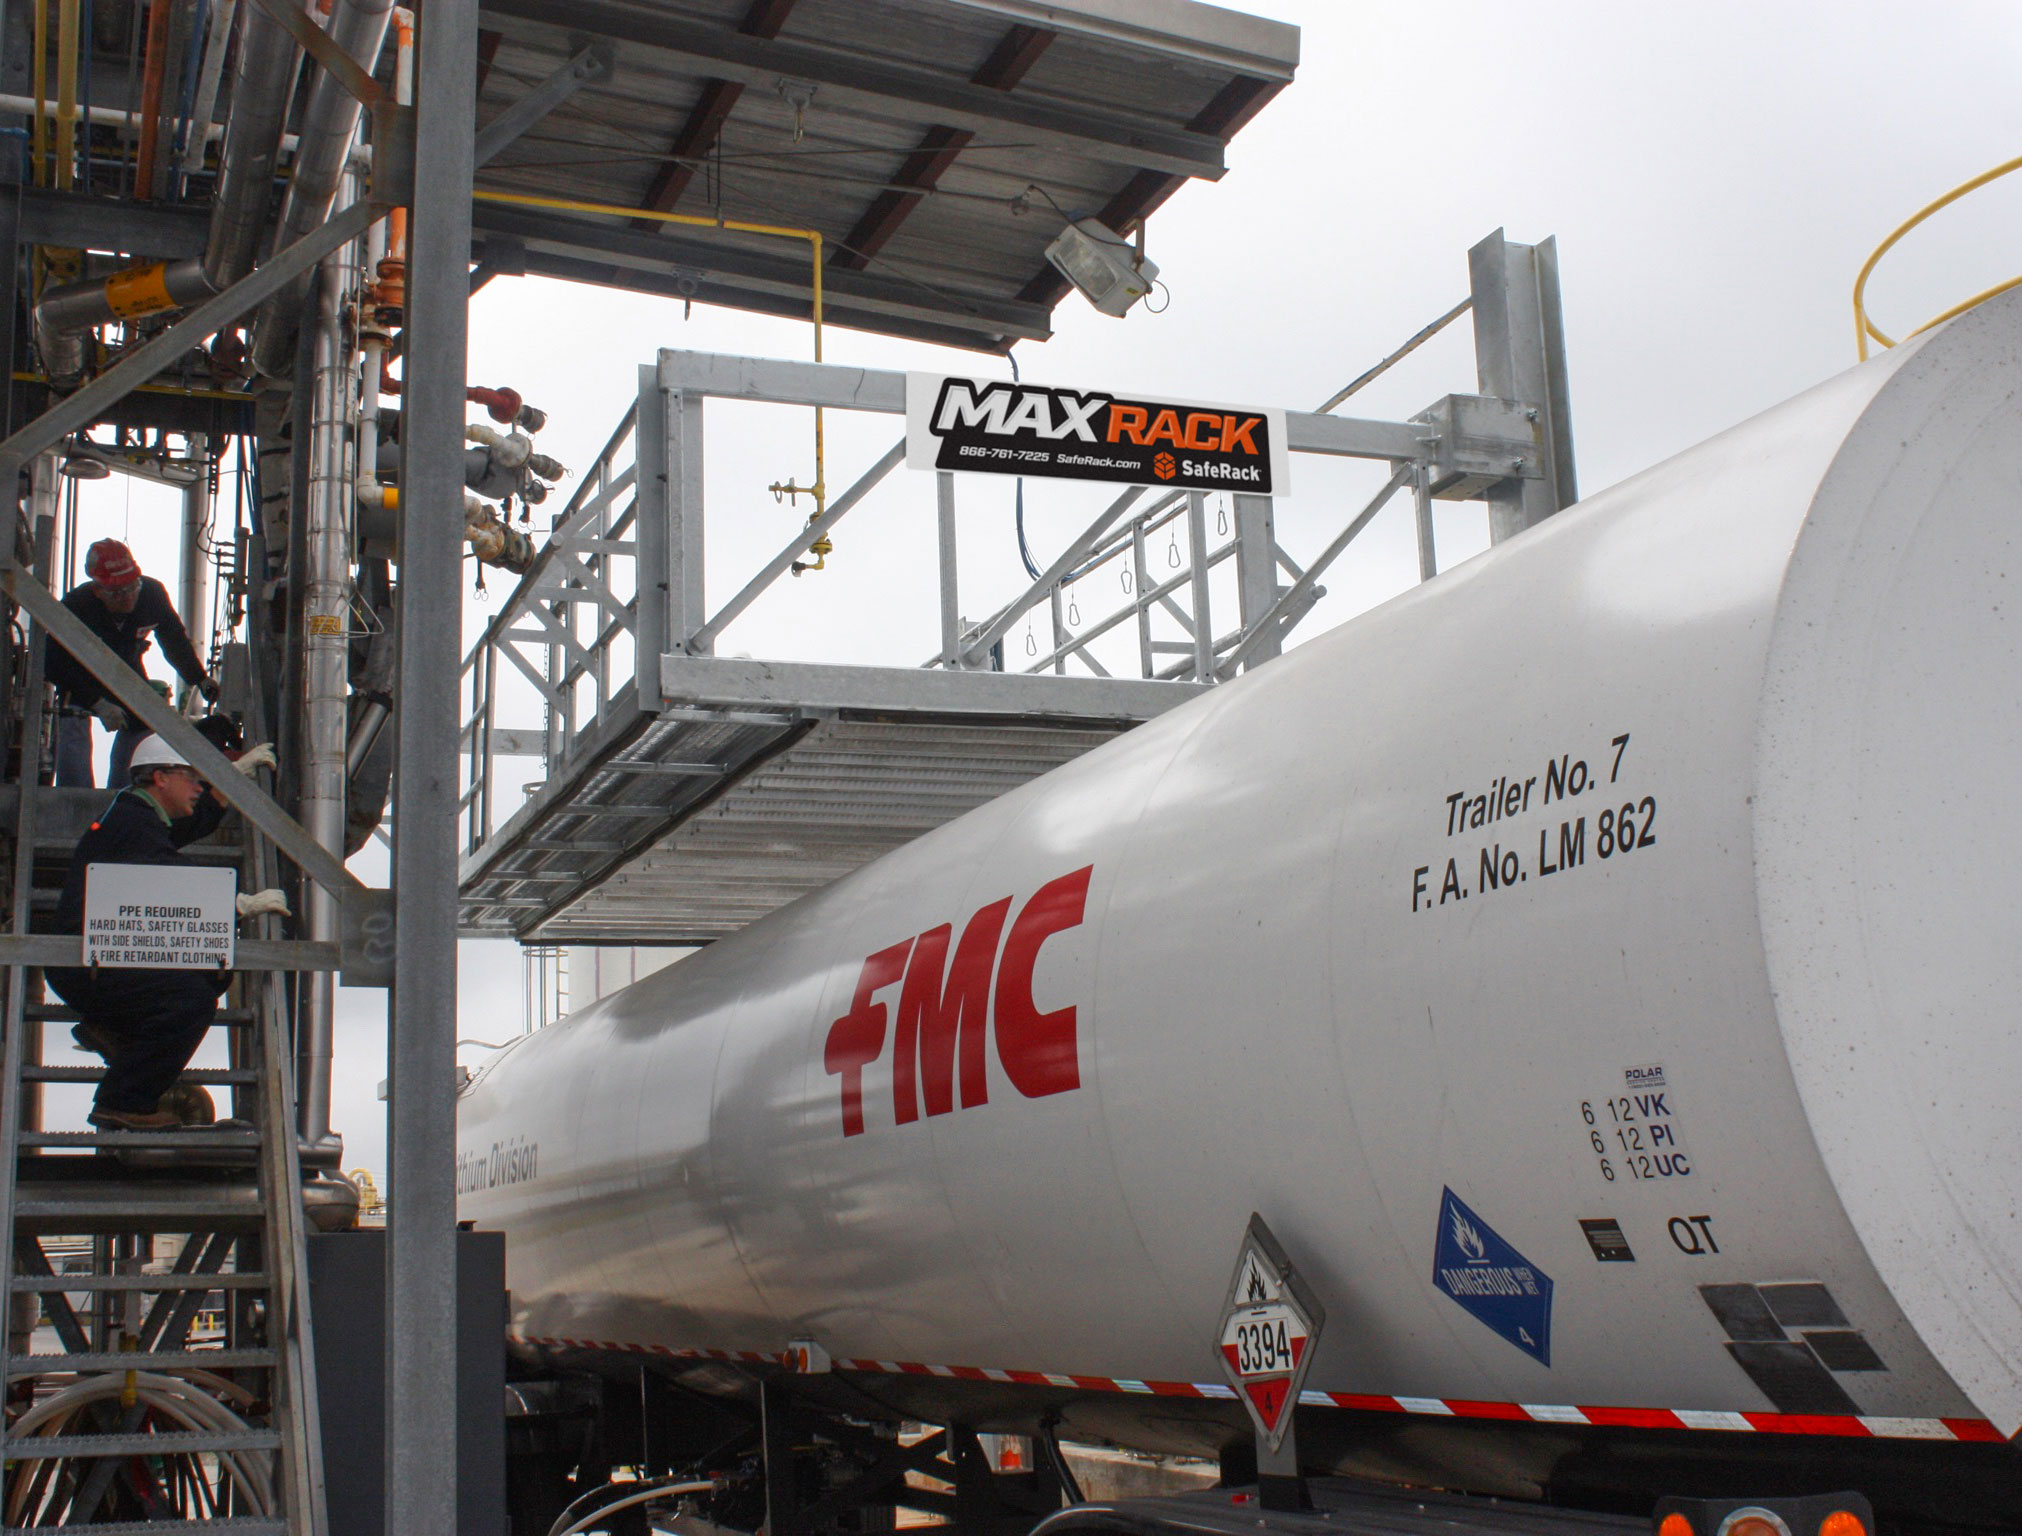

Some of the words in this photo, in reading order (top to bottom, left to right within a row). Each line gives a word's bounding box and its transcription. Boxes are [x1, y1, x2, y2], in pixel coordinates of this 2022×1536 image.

[959, 446, 1050, 462] 866-761-7225
[1056, 453, 1141, 469] SafeRack.com
[1181, 459, 1261, 481] SafeRack
[1446, 776, 1537, 837] Trailer
[1544, 754, 1595, 805] No.
[1610, 733, 1630, 783] 7
[1479, 844, 1527, 893] No.
[1539, 817, 1586, 877] LM
[1596, 796, 1656, 859] 862
[119, 905, 142, 917] PPE
[145, 906, 202, 918] REQUIRED
[90, 919, 117, 931] HARD
[118, 920, 146, 932] HATS,
[148, 921, 184, 932] SAFETY
[187, 922, 229, 933] GLASSES
[89, 935, 110, 946] WITH
[112, 935, 130, 947] SIDE
[132, 936, 168, 948] SHIELDS,
[170, 936, 201, 948] SAFETY
[203, 937, 229, 949] SHOES
[90, 950, 98, 961] &
[100, 950, 121, 962] FIRE
[124, 951, 179, 963] RETARDANT
[824, 864, 1094, 1138] FMC
[1625, 1067, 1662, 1079] POLAR
[1581, 1101, 1595, 1125] 6
[1590, 1130, 1604, 1153] 6
[1616, 1127, 1644, 1151] 12
[1649, 1124, 1675, 1147] PI
[457, 1150, 486, 1195] thium
[489, 1135, 538, 1188] Division
[1600, 1158, 1615, 1181] 6
[1668, 1215, 1720, 1255] QT
[1441, 1267, 1522, 1296] DANGEROUS
[1238, 1320, 1290, 1371] 3394
[1518, 1326, 1535, 1346] 4
[1265, 1392, 1273, 1414] 4
